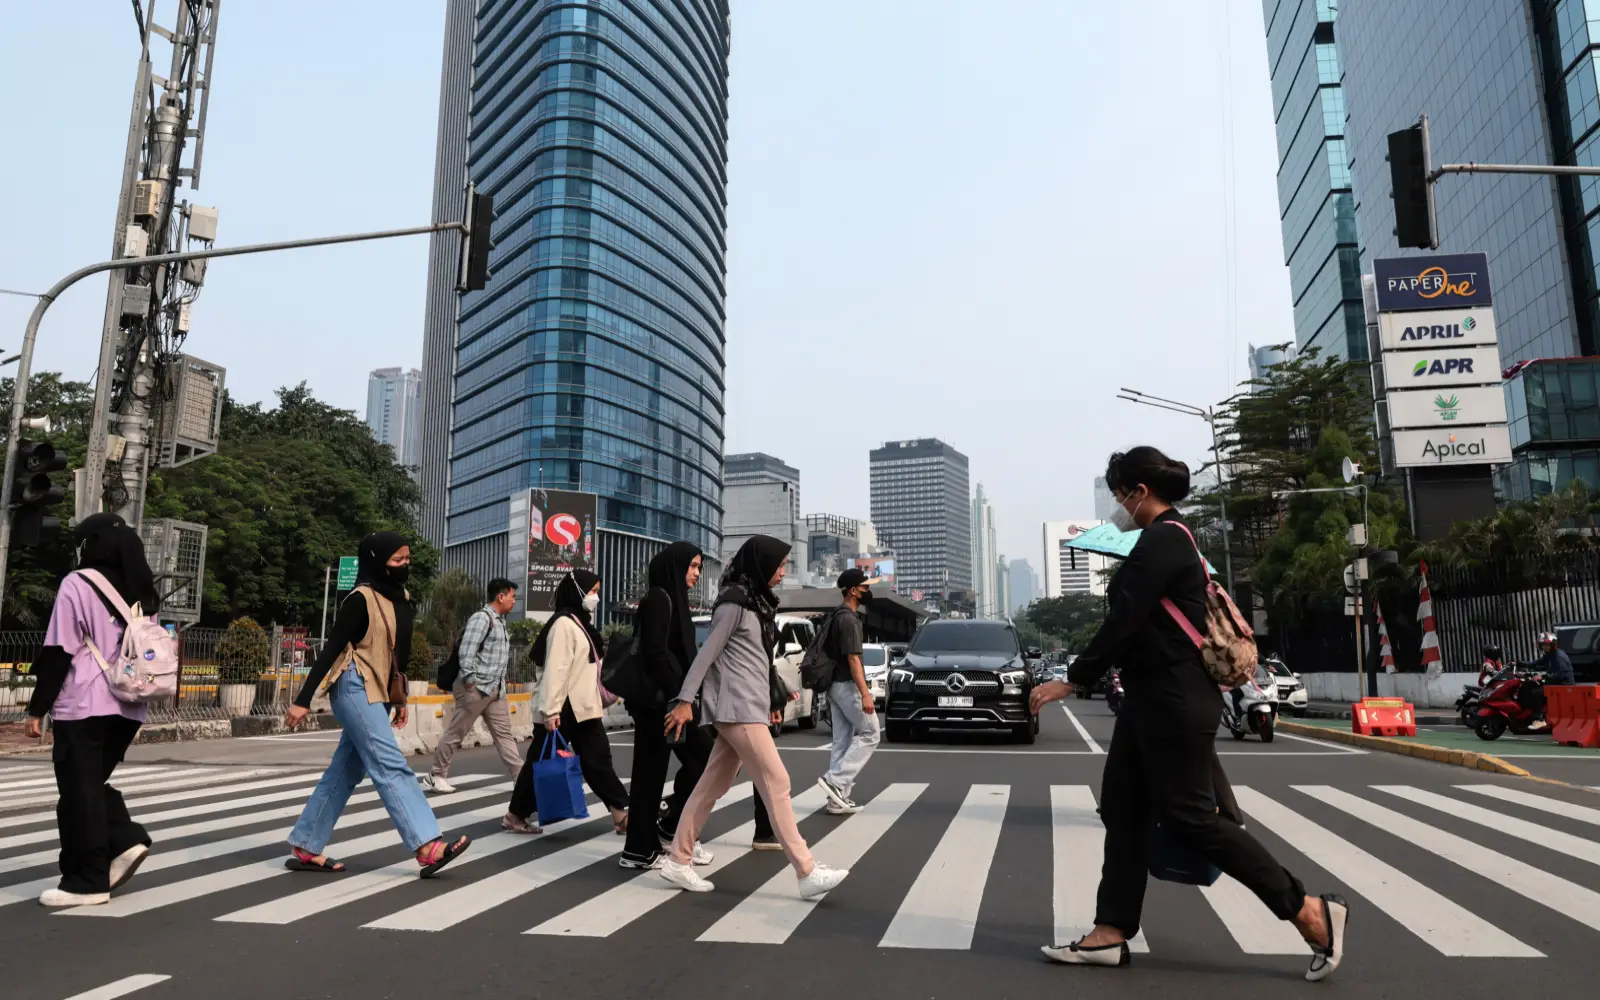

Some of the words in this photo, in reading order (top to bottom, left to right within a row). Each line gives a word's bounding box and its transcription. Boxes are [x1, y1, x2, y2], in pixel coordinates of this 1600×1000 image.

[1388, 277, 1443, 292] PAPER
[1418, 266, 1476, 299] One
[1400, 324, 1464, 341] APRIL
[1427, 358, 1474, 375] APR
[1422, 434, 1486, 463] Apical
